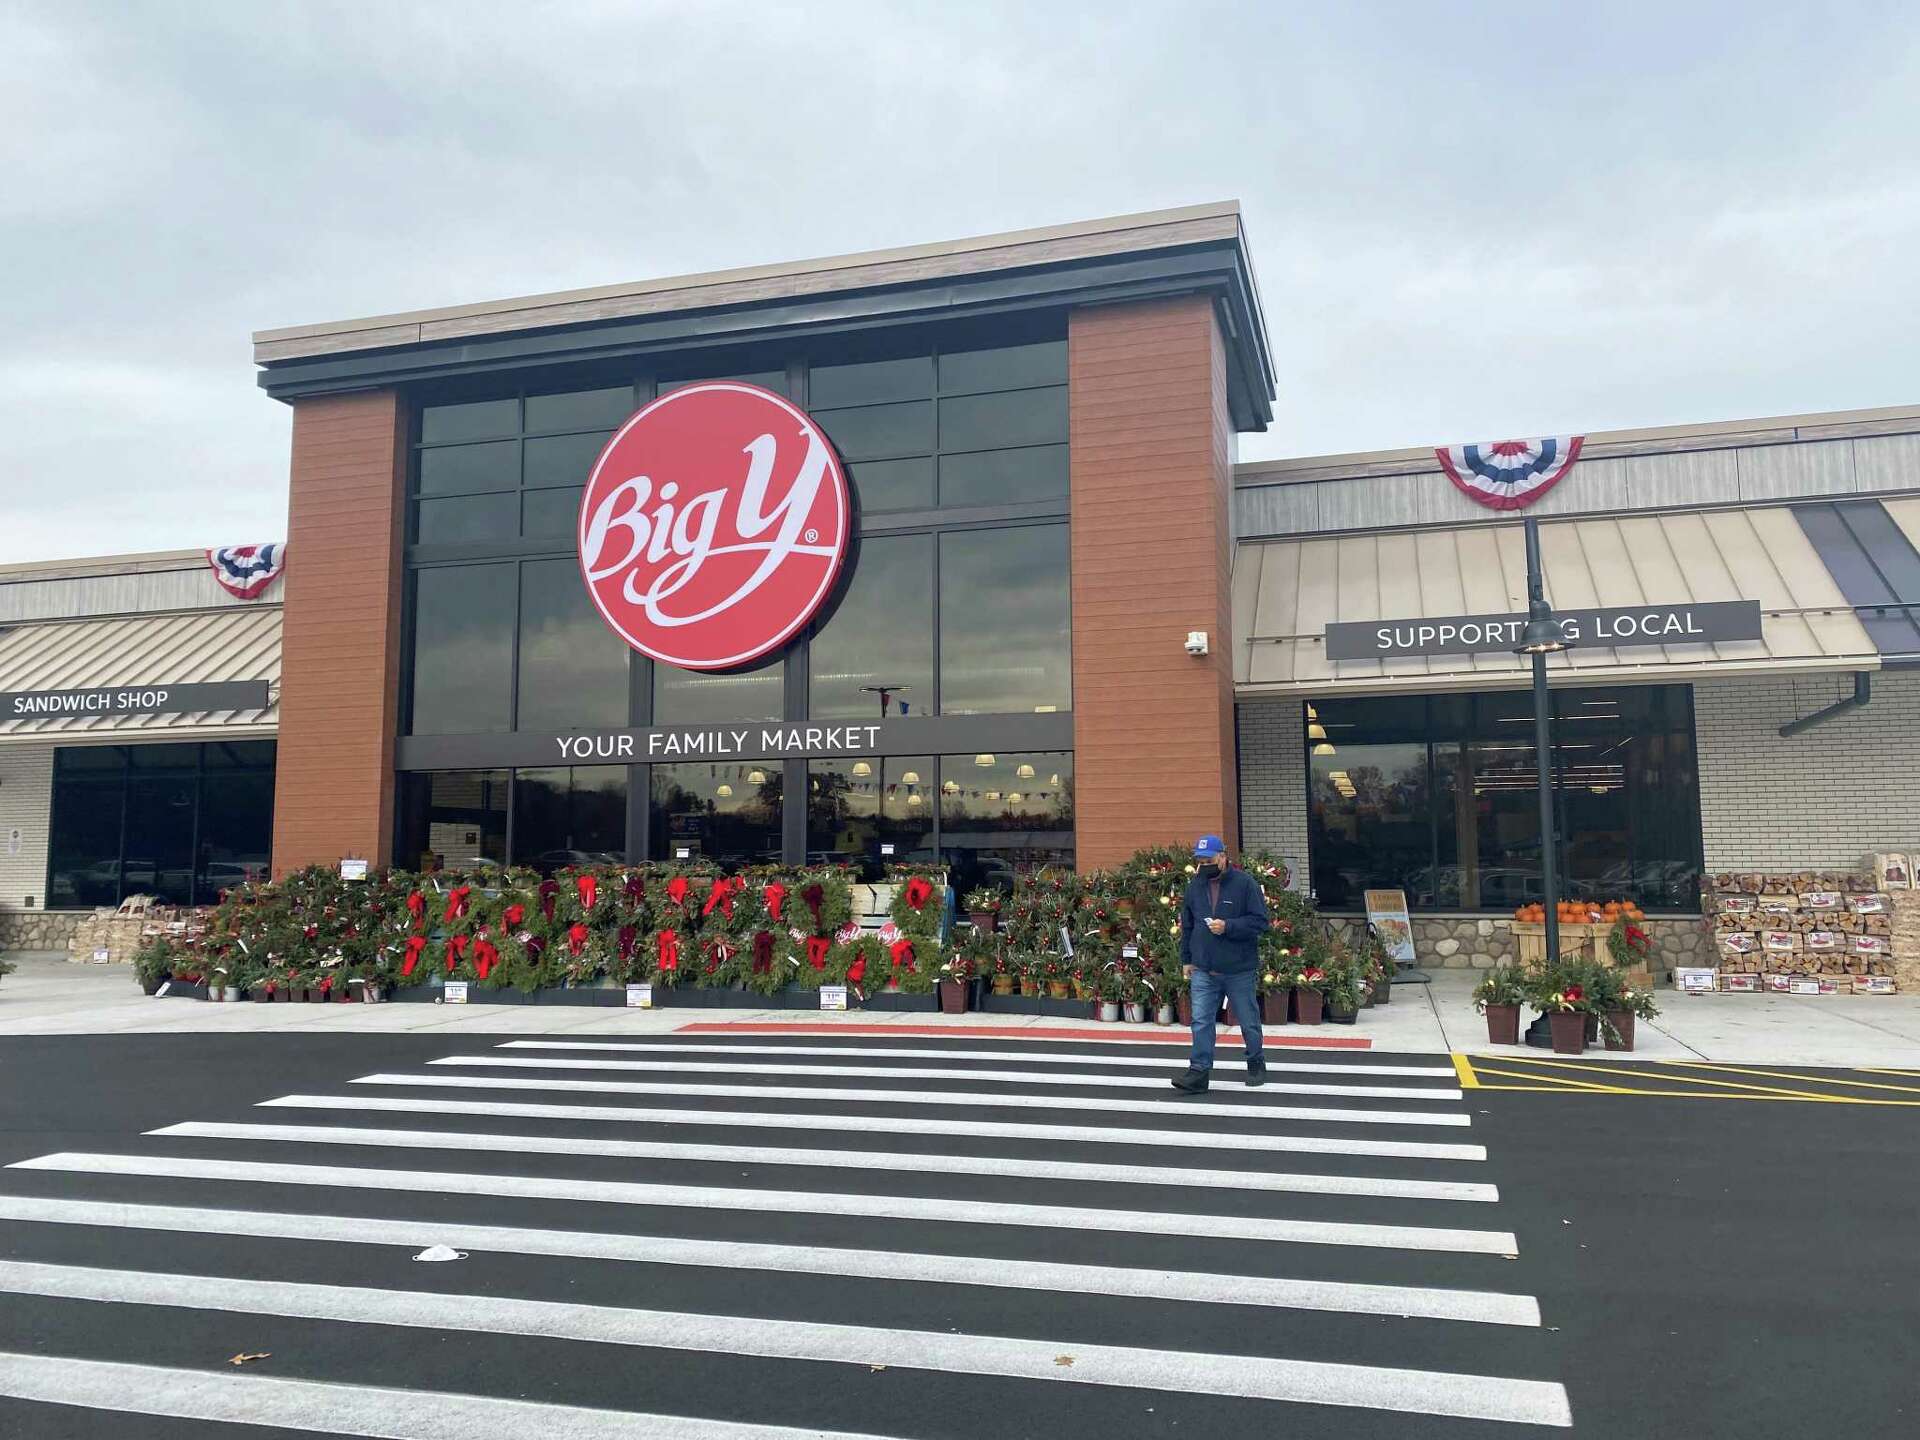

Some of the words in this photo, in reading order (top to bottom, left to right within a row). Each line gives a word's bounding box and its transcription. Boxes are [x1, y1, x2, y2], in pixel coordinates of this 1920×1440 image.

[584, 475, 728, 605] Big
[1376, 618, 1580, 649] SUPPORTG
[1595, 612, 1703, 638] LOCAL
[13, 693, 111, 714] SANDWICH
[116, 690, 168, 709] SHOP
[556, 735, 634, 758] YOUR
[648, 730, 748, 755] FAMILY
[761, 726, 881, 751] MARKET
